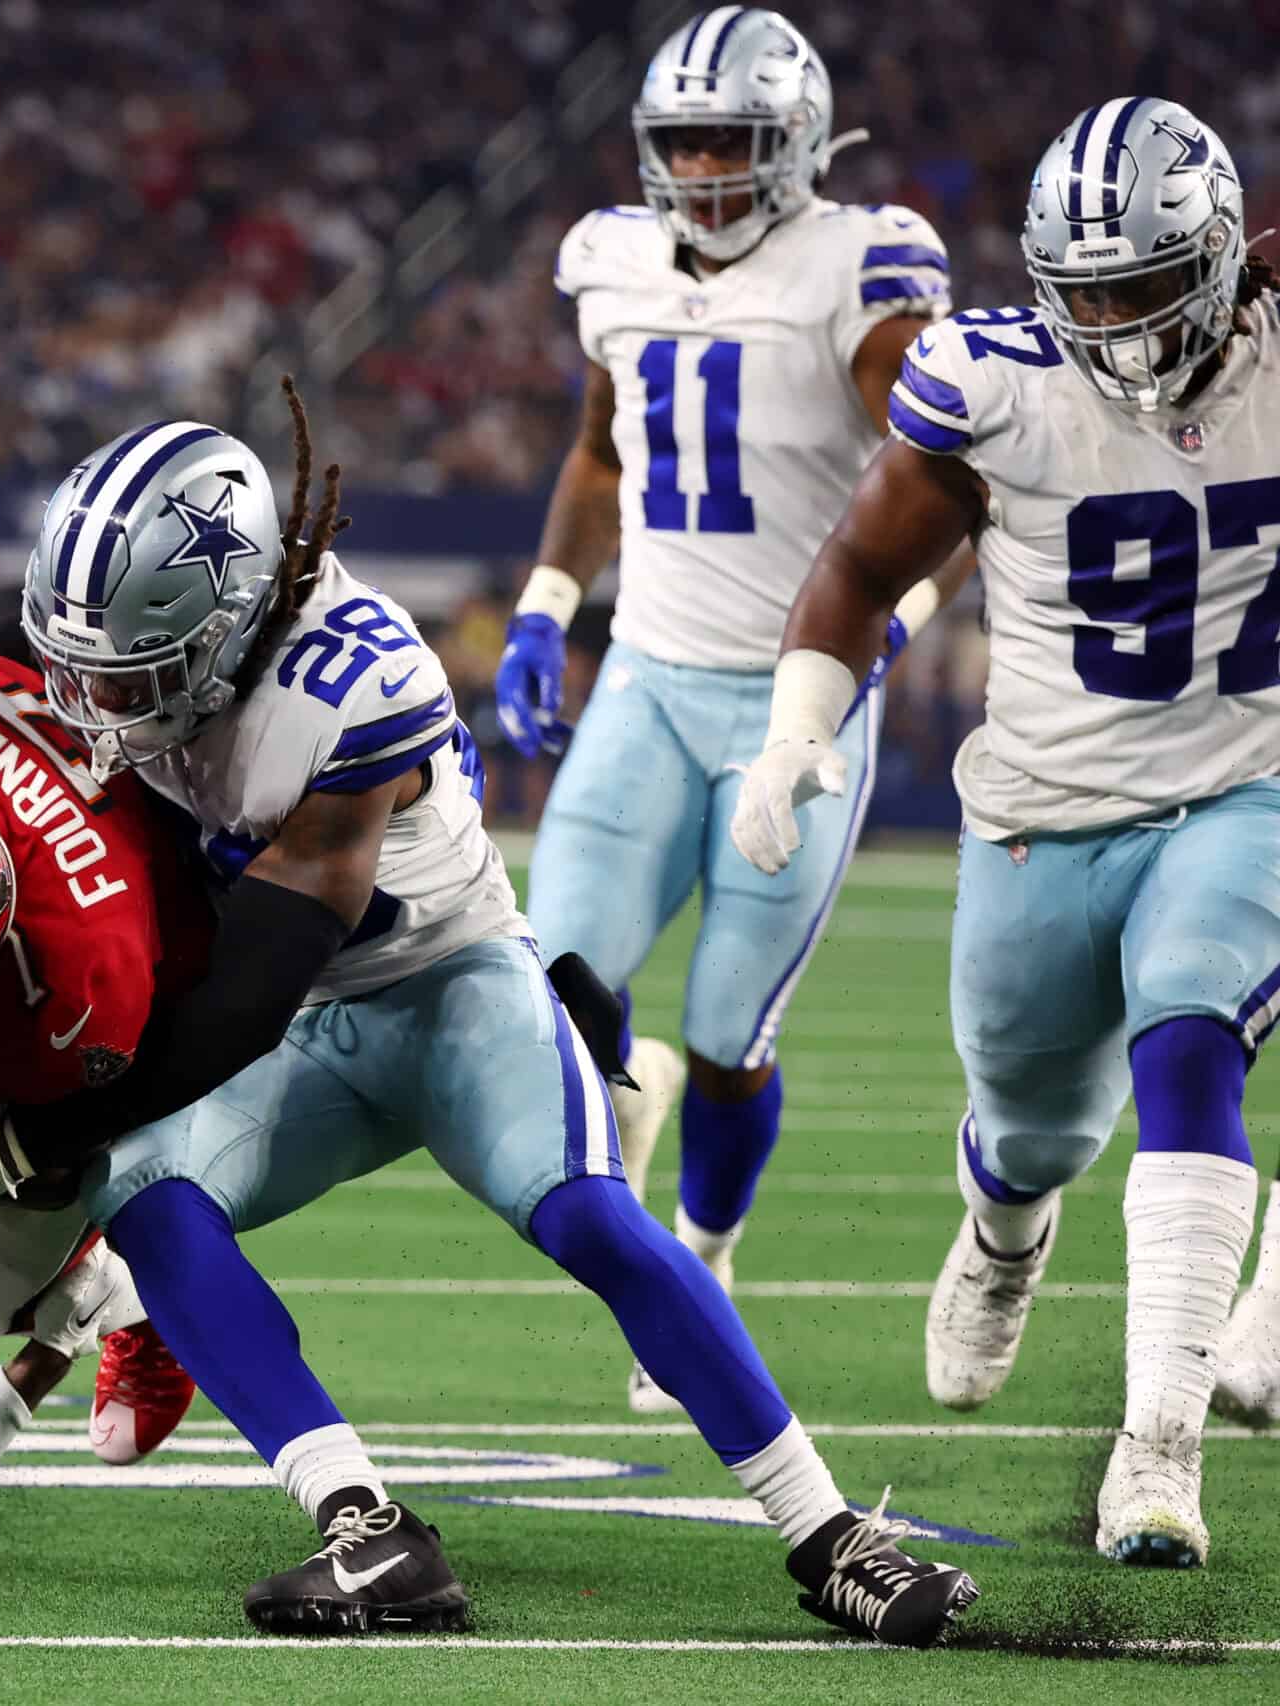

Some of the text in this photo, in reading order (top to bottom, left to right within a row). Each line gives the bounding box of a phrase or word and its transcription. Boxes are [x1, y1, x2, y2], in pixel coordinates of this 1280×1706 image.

[638, 340, 755, 534] 11
[278, 597, 423, 709] 28
[1066, 476, 1280, 701] 97
